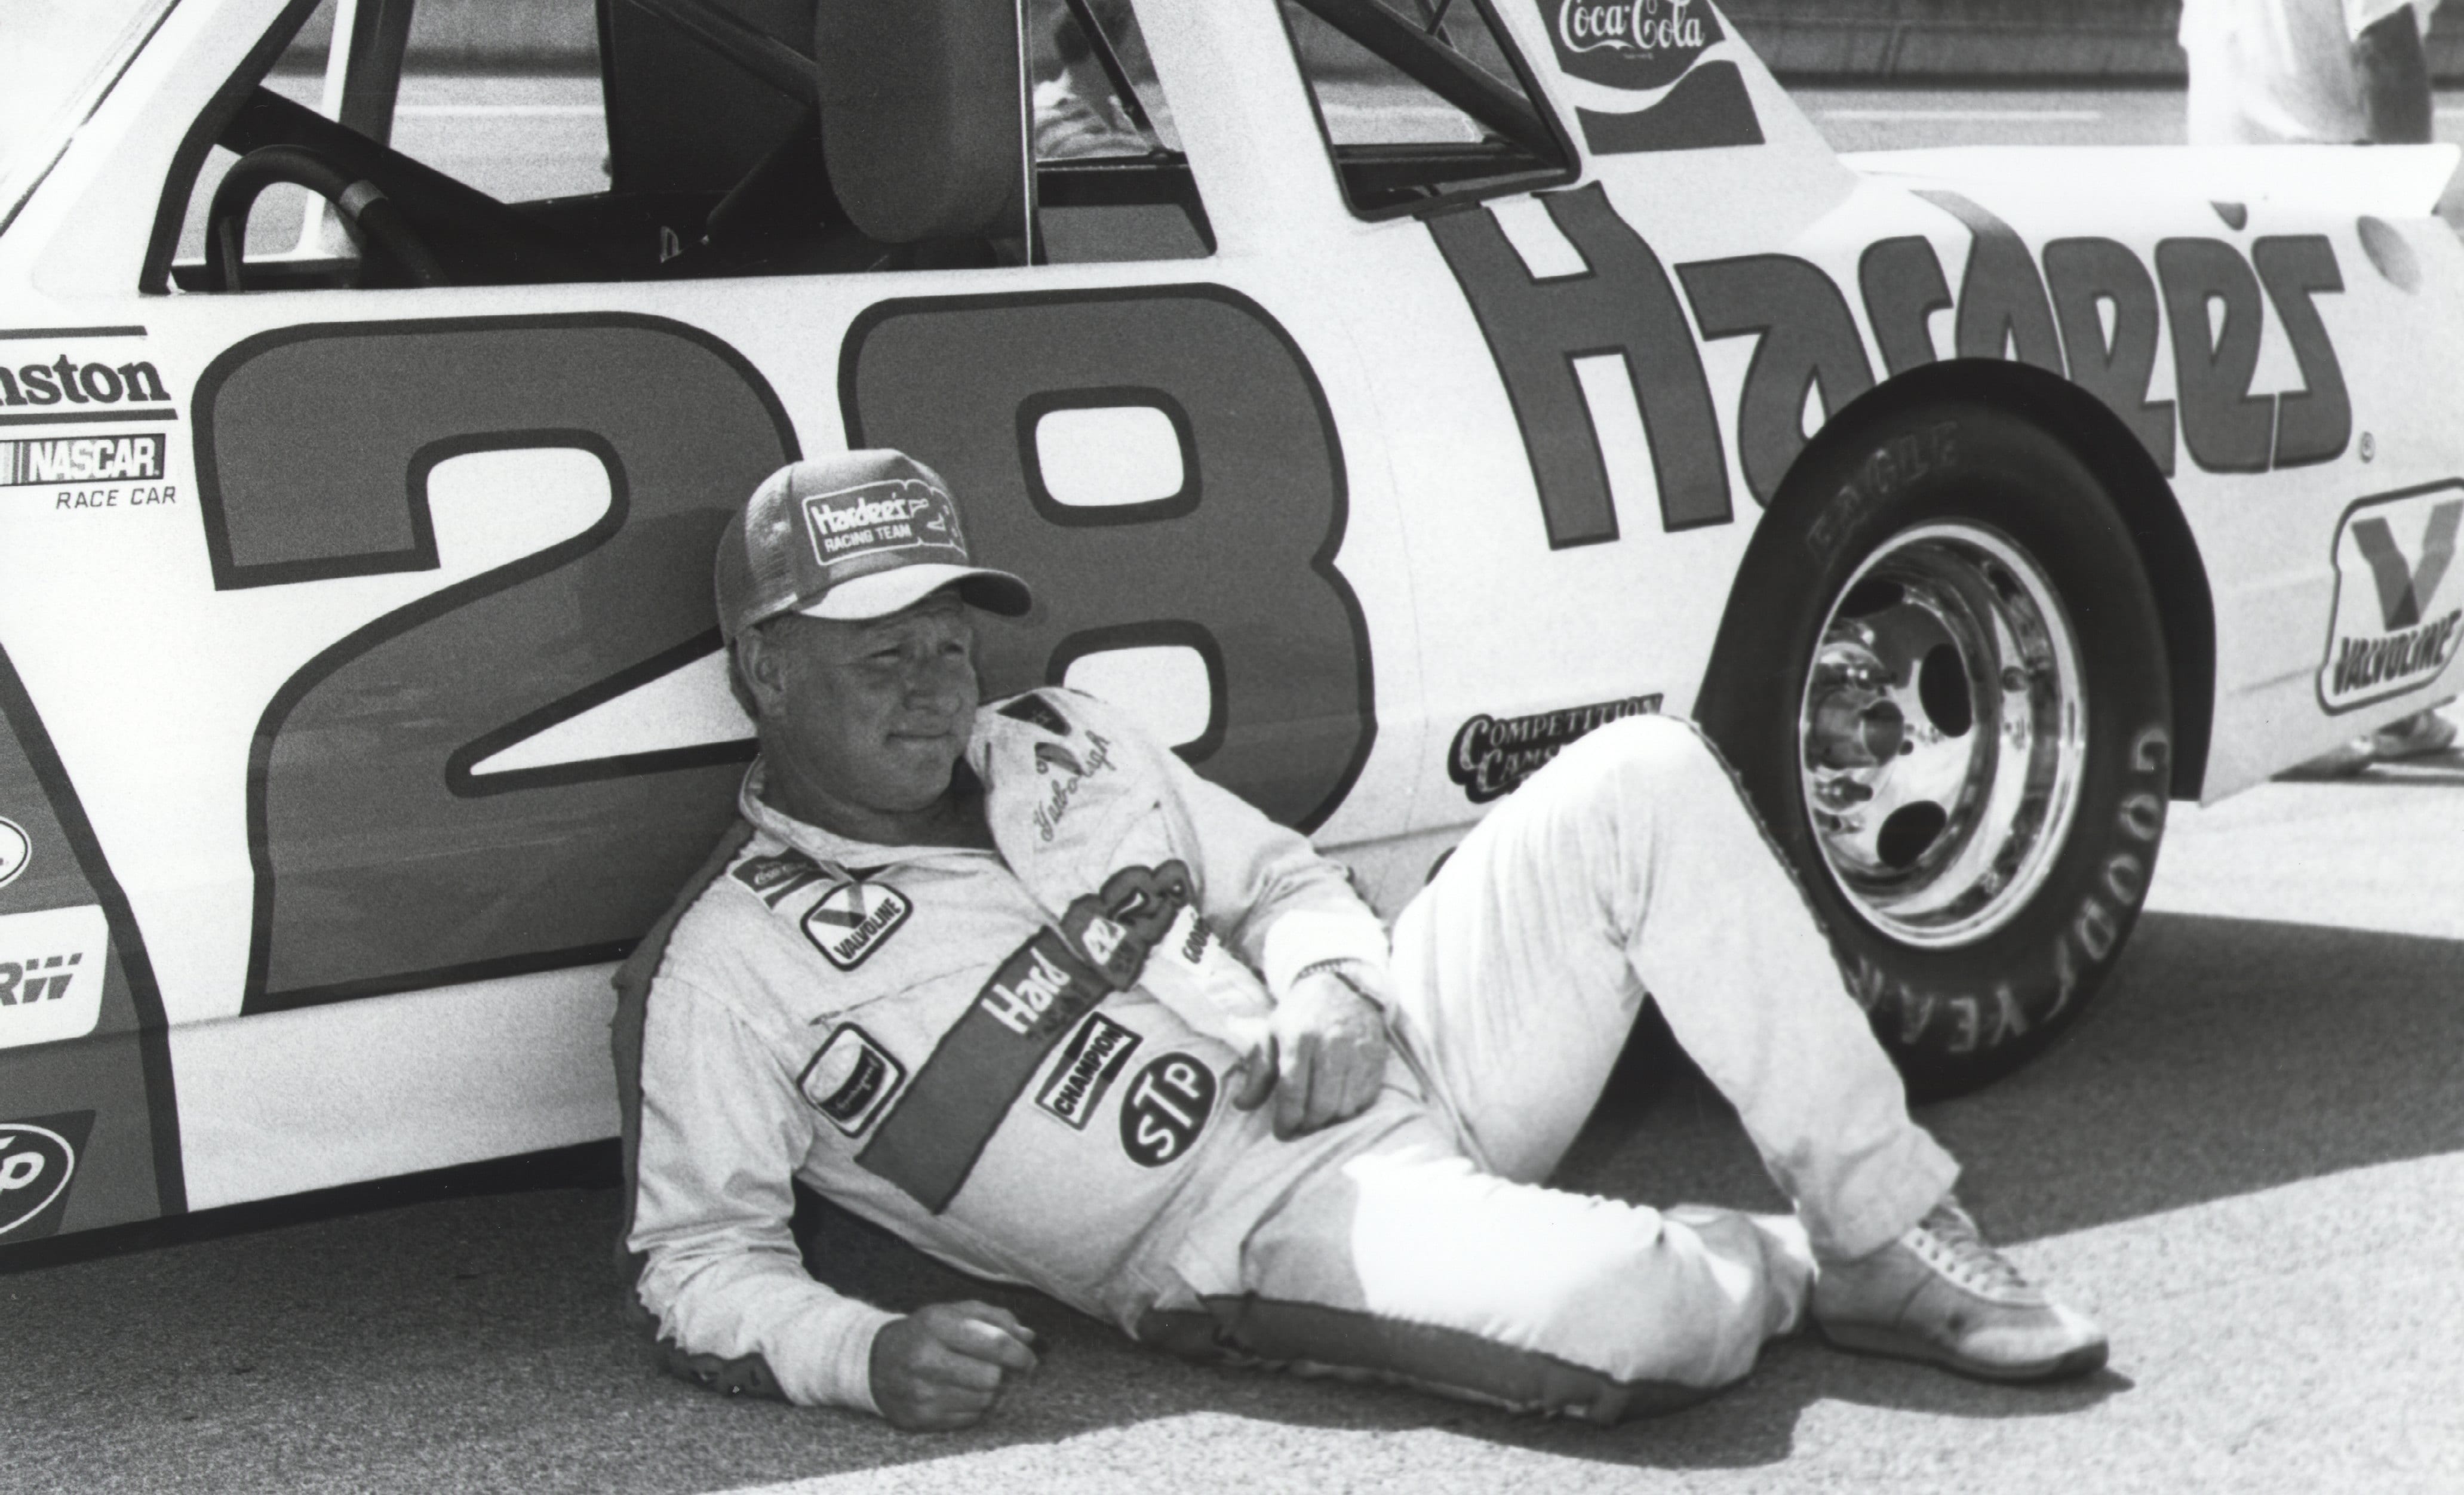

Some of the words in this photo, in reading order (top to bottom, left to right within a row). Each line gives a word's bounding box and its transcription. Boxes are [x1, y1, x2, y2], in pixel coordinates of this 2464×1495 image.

[1559, 0, 1705, 53] Coca-Cola
[30, 436, 155, 482] NASCAR
[56, 490, 119, 509] RACE
[130, 486, 176, 505] CAR
[810, 492, 910, 535] Hardee's
[824, 528, 874, 552] RACING
[875, 523, 912, 540] TEAM
[191, 282, 1377, 1015] 28
[833, 897, 901, 960] VALVOLINE
[1053, 1026, 1124, 1116] CHAMPION
[1133, 1062, 1200, 1158] STP
